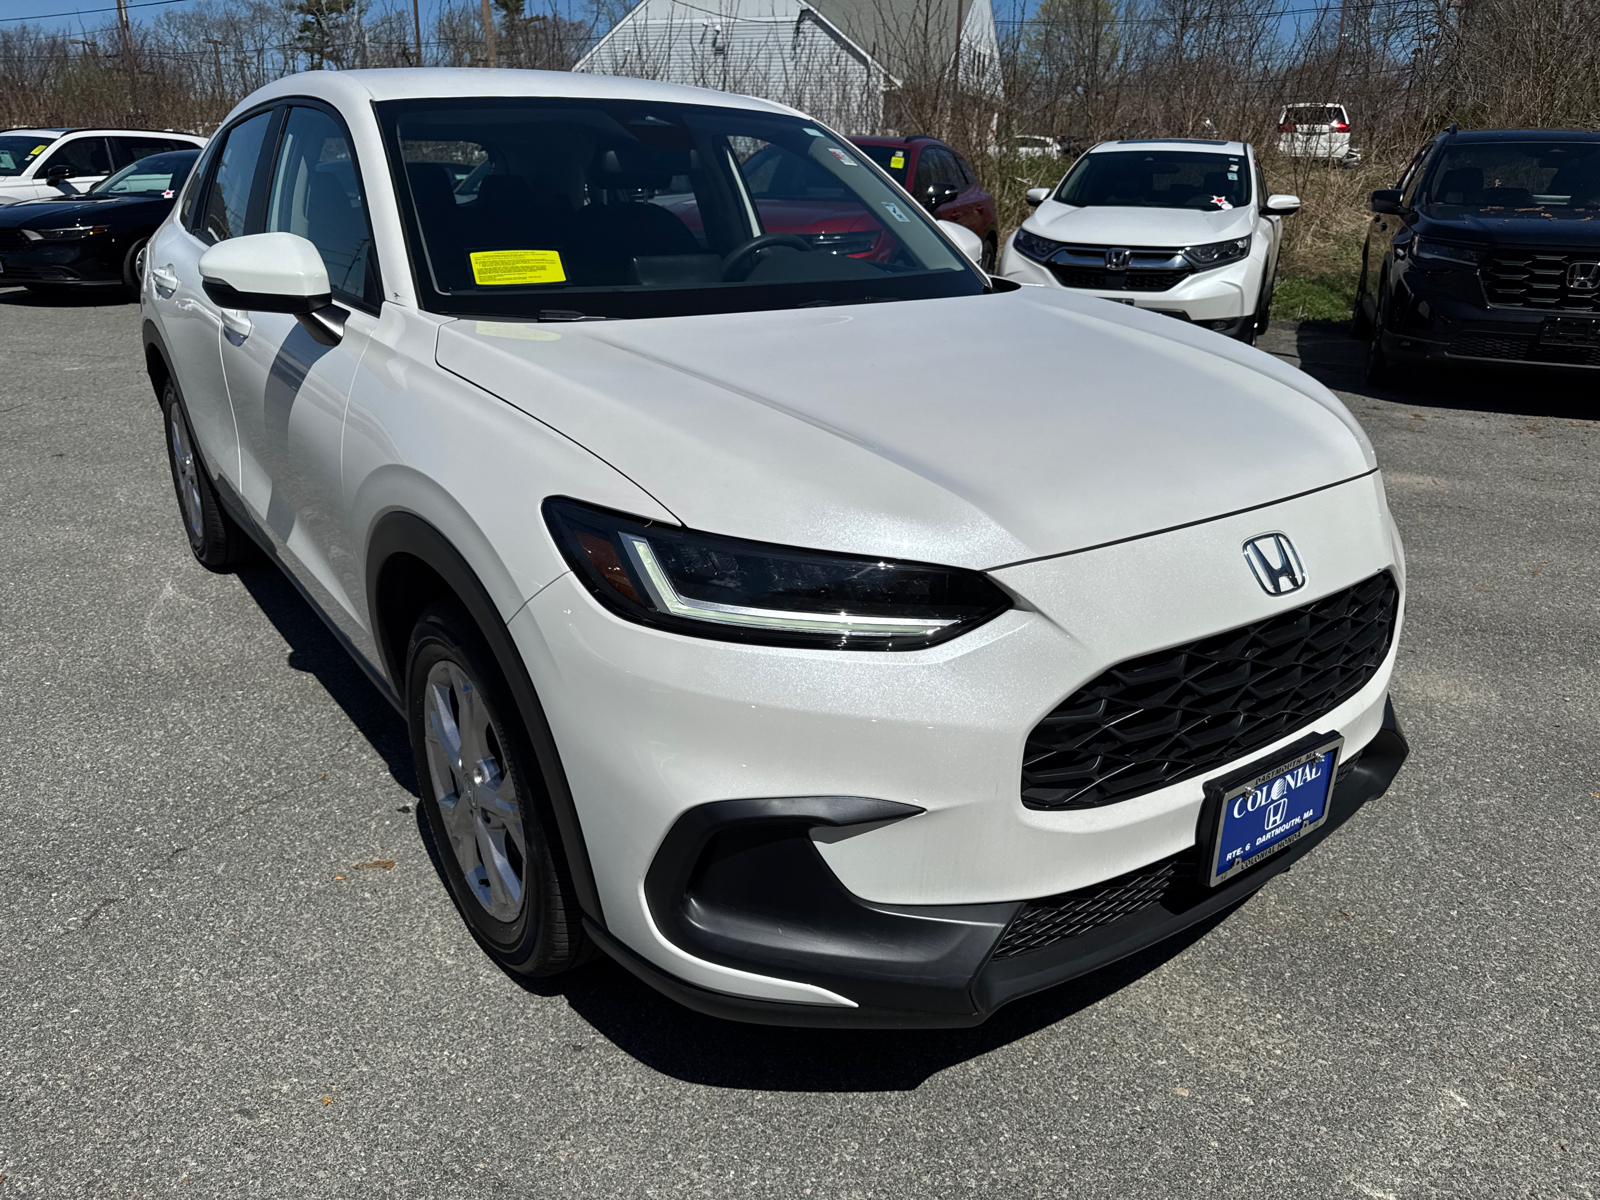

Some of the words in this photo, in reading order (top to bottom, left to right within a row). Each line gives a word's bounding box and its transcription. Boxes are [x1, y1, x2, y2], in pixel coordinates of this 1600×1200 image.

[1233, 763, 1322, 819] COLONIAL
[1226, 847, 1244, 861] RTE.
[1245, 843, 1251, 851] 6
[1256, 816, 1302, 846] DARTMOUTH,
[1303, 809, 1314, 820] MA
[1241, 846, 1275, 870] COLONIAL
[1277, 832, 1301, 850] HONDA
